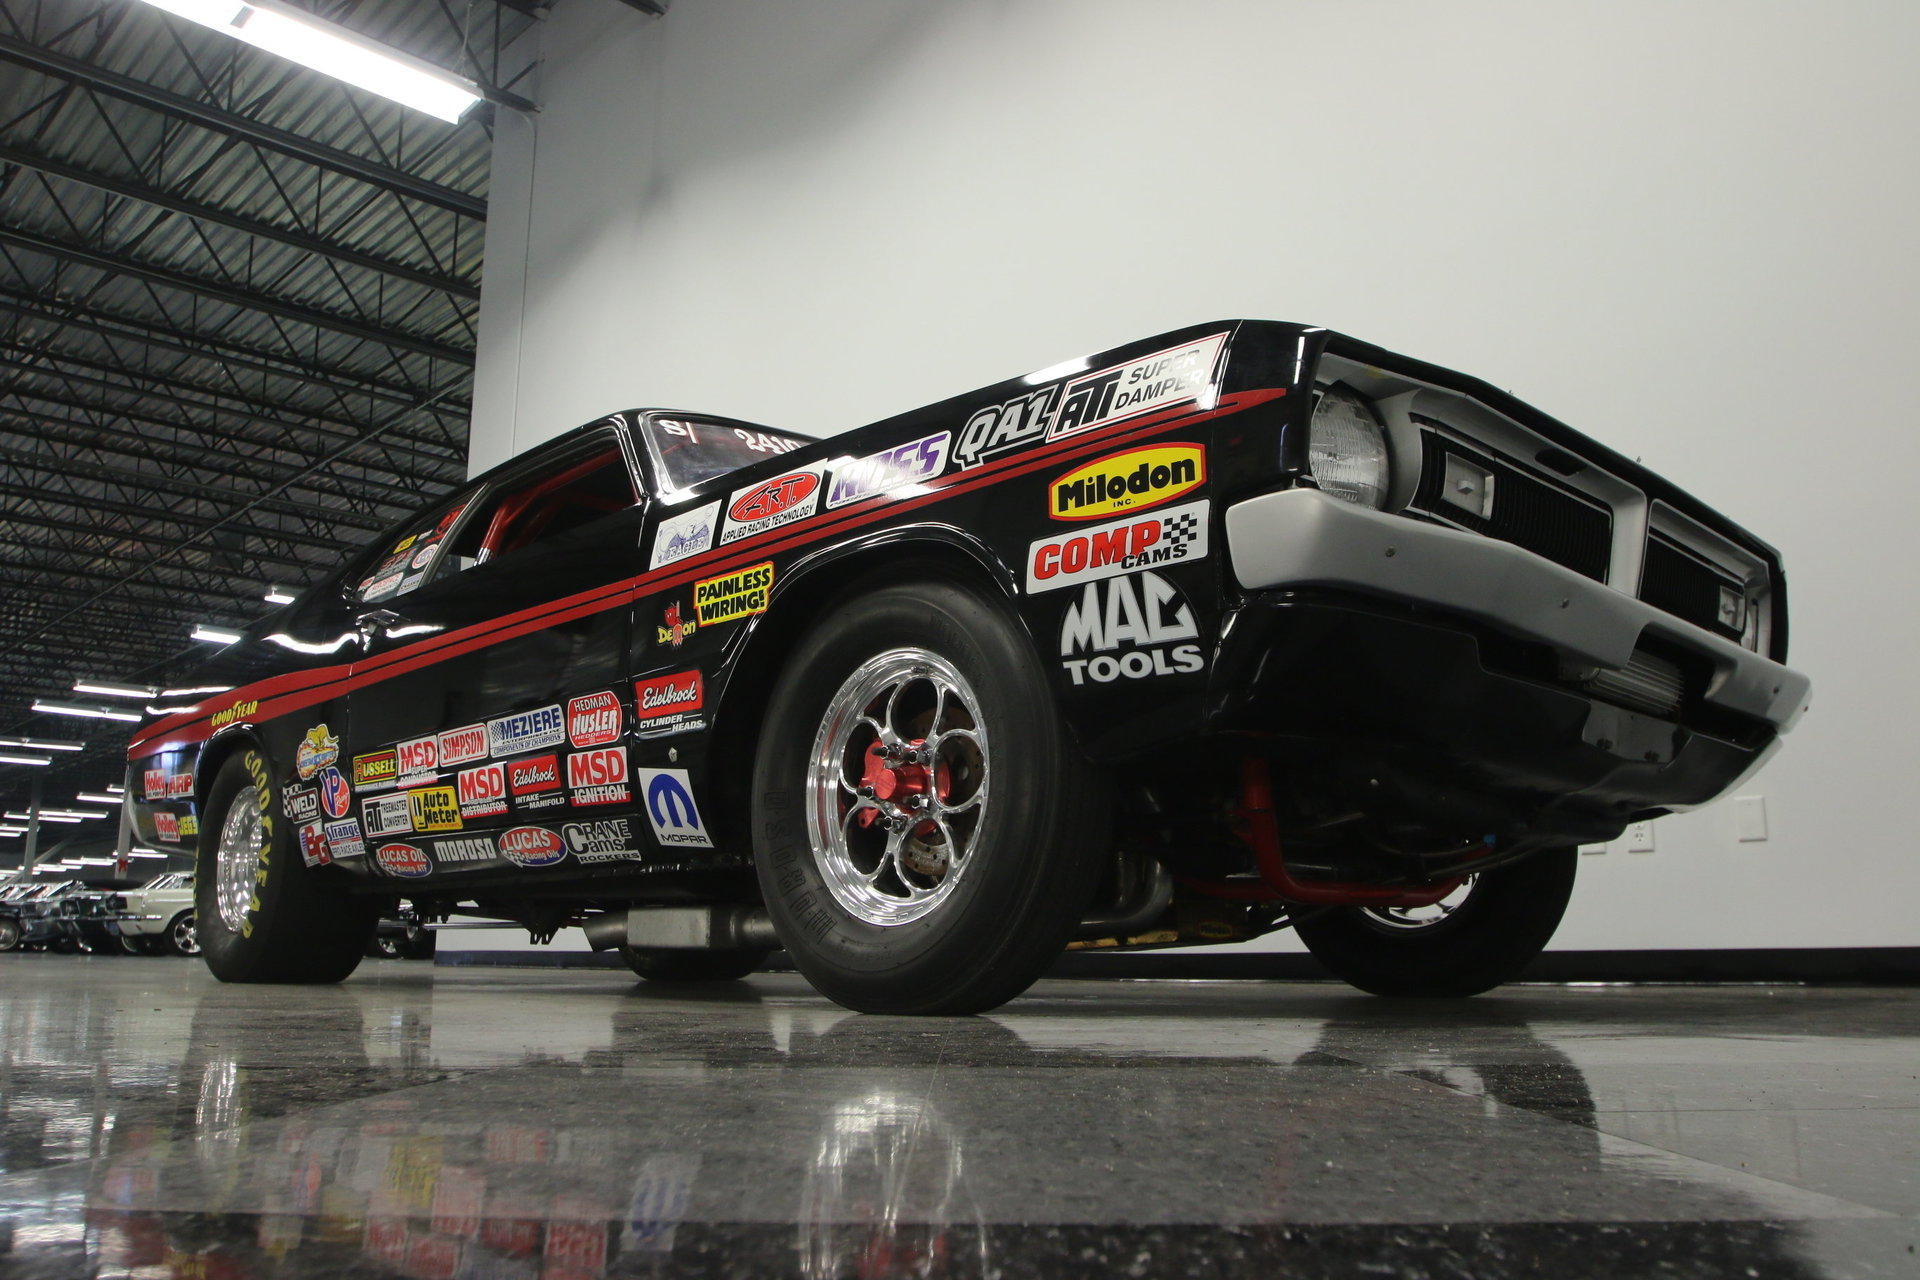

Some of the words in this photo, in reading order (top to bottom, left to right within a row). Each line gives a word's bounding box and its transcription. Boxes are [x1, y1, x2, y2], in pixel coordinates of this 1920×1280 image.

[1129, 350, 1200, 385] SUPER
[1114, 369, 1204, 410] DAMPER
[954, 387, 1058, 470] QA1
[1058, 458, 1195, 512] Milodon
[1112, 499, 1136, 508] INC.
[721, 523, 746, 543] APPLIED
[747, 517, 770, 535] RACING
[770, 504, 814, 528] TECHNOLOGY
[667, 537, 705, 560] EAGLE
[1034, 520, 1161, 580] COMP
[1121, 543, 1188, 569] CAMS
[697, 568, 771, 604] PAINLESS
[699, 590, 766, 622] WIRING!
[1061, 571, 1199, 656] MAC
[1063, 645, 1204, 685] TOOLS
[573, 695, 611, 712] HEDMAN
[642, 681, 697, 709] Edelbrock
[498, 707, 562, 740] MEZIERE
[572, 708, 617, 737] HUSLER
[640, 714, 683, 729] CYLINDER
[672, 720, 703, 732] HEADS
[442, 729, 484, 760] SIMPSON
[399, 741, 437, 774] MSD
[571, 750, 625, 787] MSD
[354, 758, 396, 782] RUSSELL
[513, 760, 556, 787] Edelbrock
[168, 775, 193, 793] ARP
[319, 768, 341, 816] VP
[460, 767, 504, 804] MSD
[573, 784, 627, 804] IGNITION
[290, 793, 317, 813] WELD
[381, 798, 408, 814] TREEMASTER
[424, 791, 449, 810] Auto
[462, 801, 507, 817] DISTRIBUTOR
[515, 793, 540, 804] INTAKE
[529, 797, 565, 809] MANIFOLD
[383, 814, 409, 828] CONVERTER
[424, 806, 458, 827] Meter
[326, 822, 360, 842] Strange
[503, 829, 551, 851] LUCAS
[562, 819, 632, 855] CRANE
[660, 833, 709, 844] MOPAR
[378, 849, 408, 862] LUCAS
[410, 849, 427, 862] OIL
[433, 838, 497, 863] MOROSO
[524, 851, 547, 863] Racing
[547, 850, 561, 860] Oils
[580, 852, 640, 862] ROCKERS
